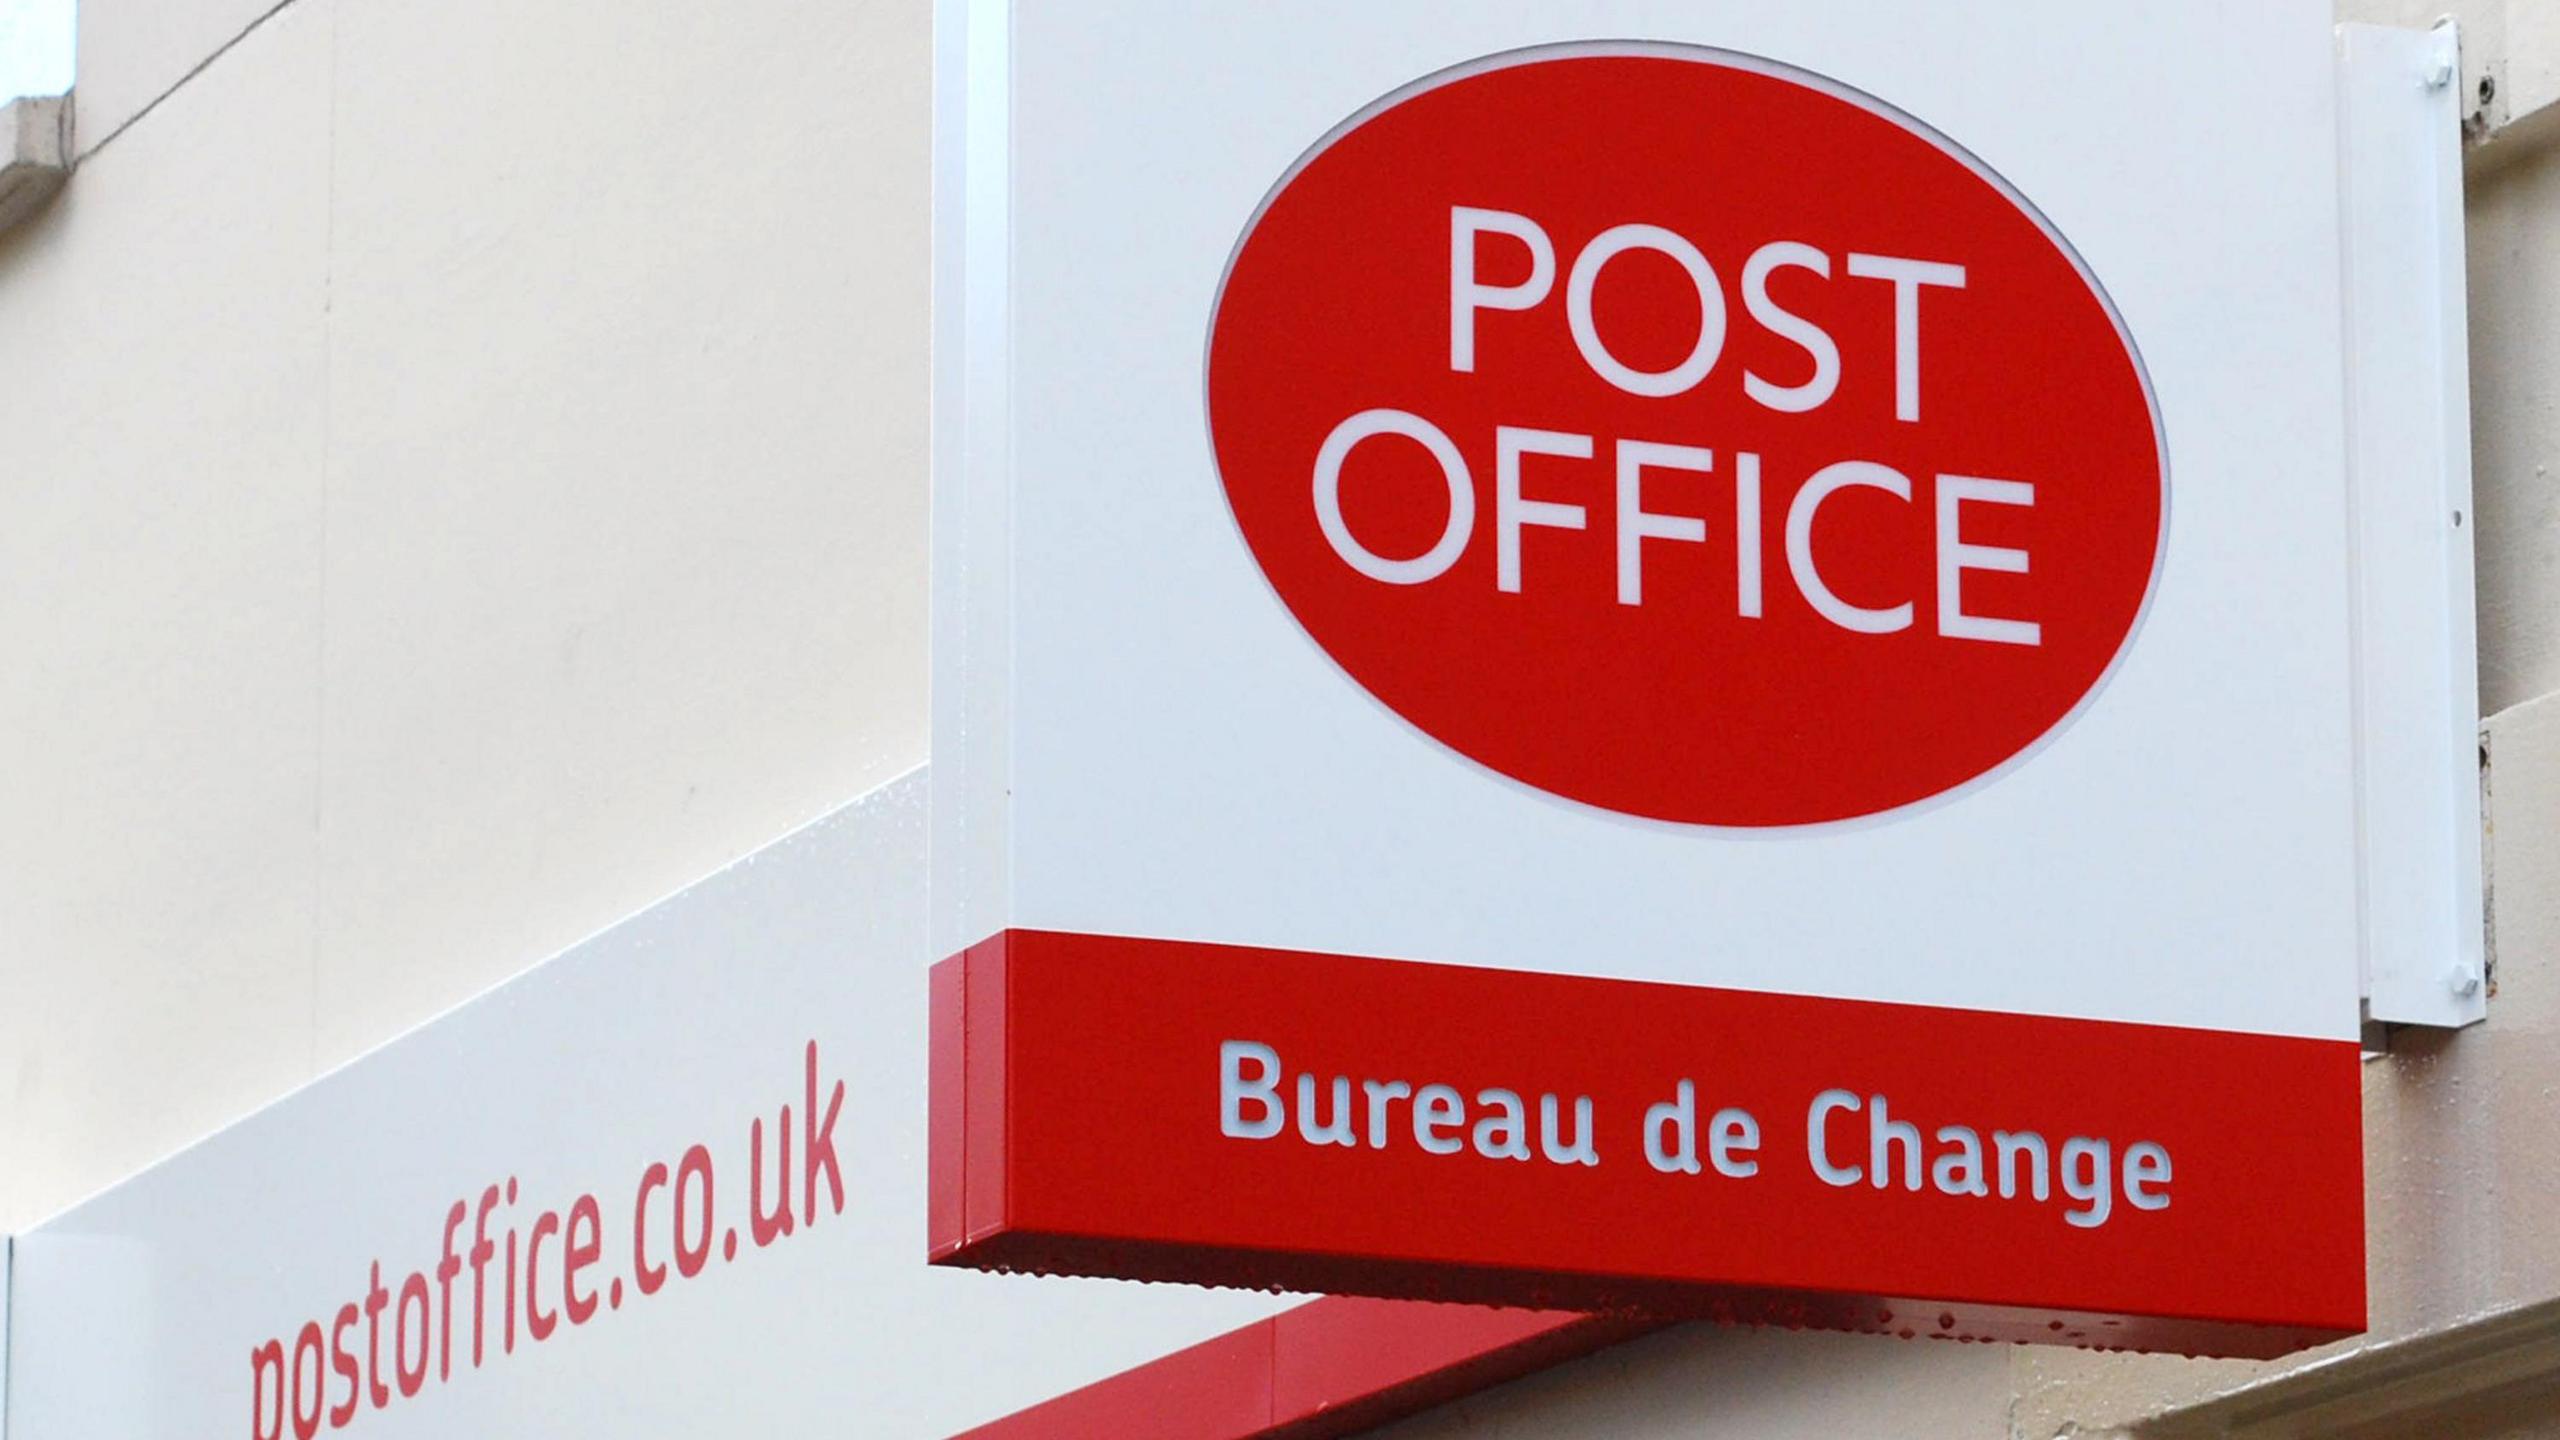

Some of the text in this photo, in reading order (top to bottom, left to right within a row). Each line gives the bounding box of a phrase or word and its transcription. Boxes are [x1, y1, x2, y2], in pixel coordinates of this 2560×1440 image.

[1449, 204, 1967, 423] POST
[1311, 407, 2042, 647] OFFICE
[251, 1041, 845, 1440] postoffice.co.uk
[1219, 1039, 2173, 1229] Bureau de Change
